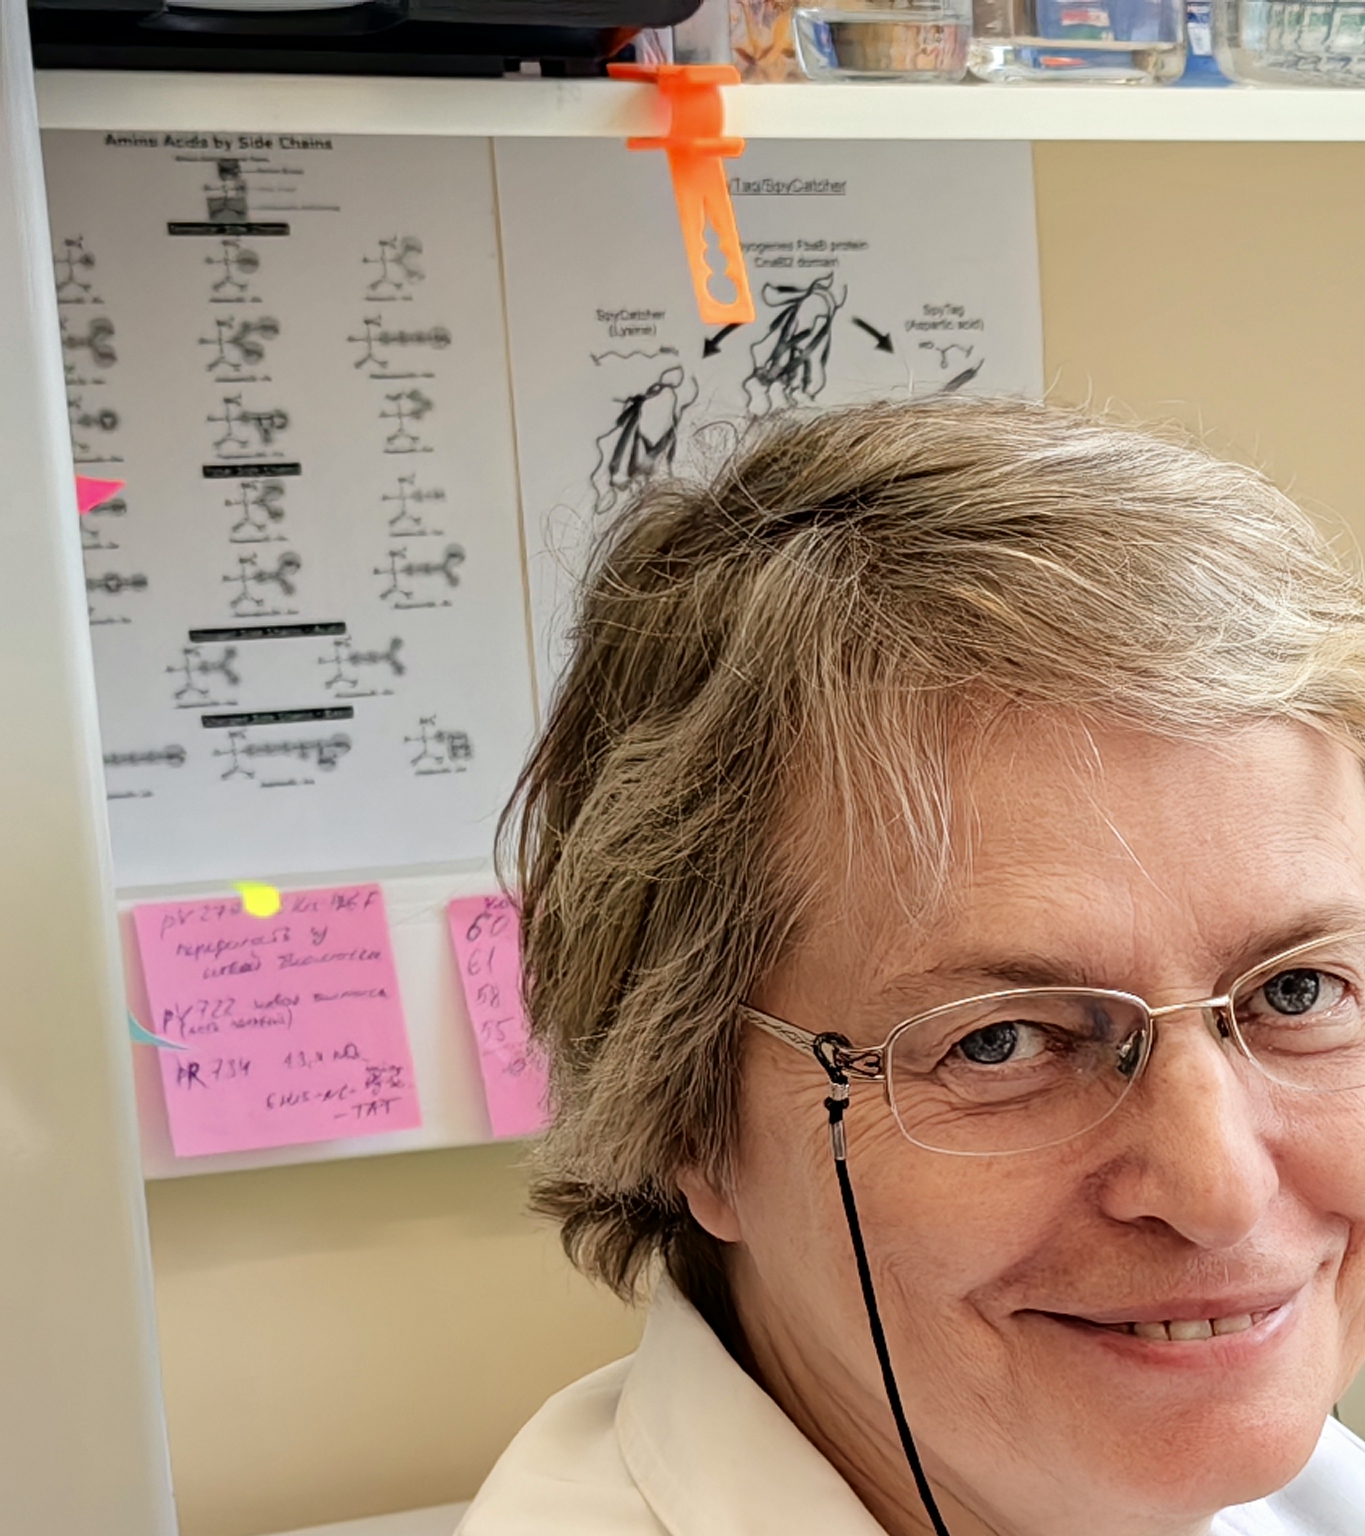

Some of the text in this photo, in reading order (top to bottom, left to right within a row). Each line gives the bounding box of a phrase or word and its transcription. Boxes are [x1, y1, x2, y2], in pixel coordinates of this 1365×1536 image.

[104, 134, 333, 151] Amino Acids by Side Chains
[730, 177, 847, 196] Tag/SpyCatcher
